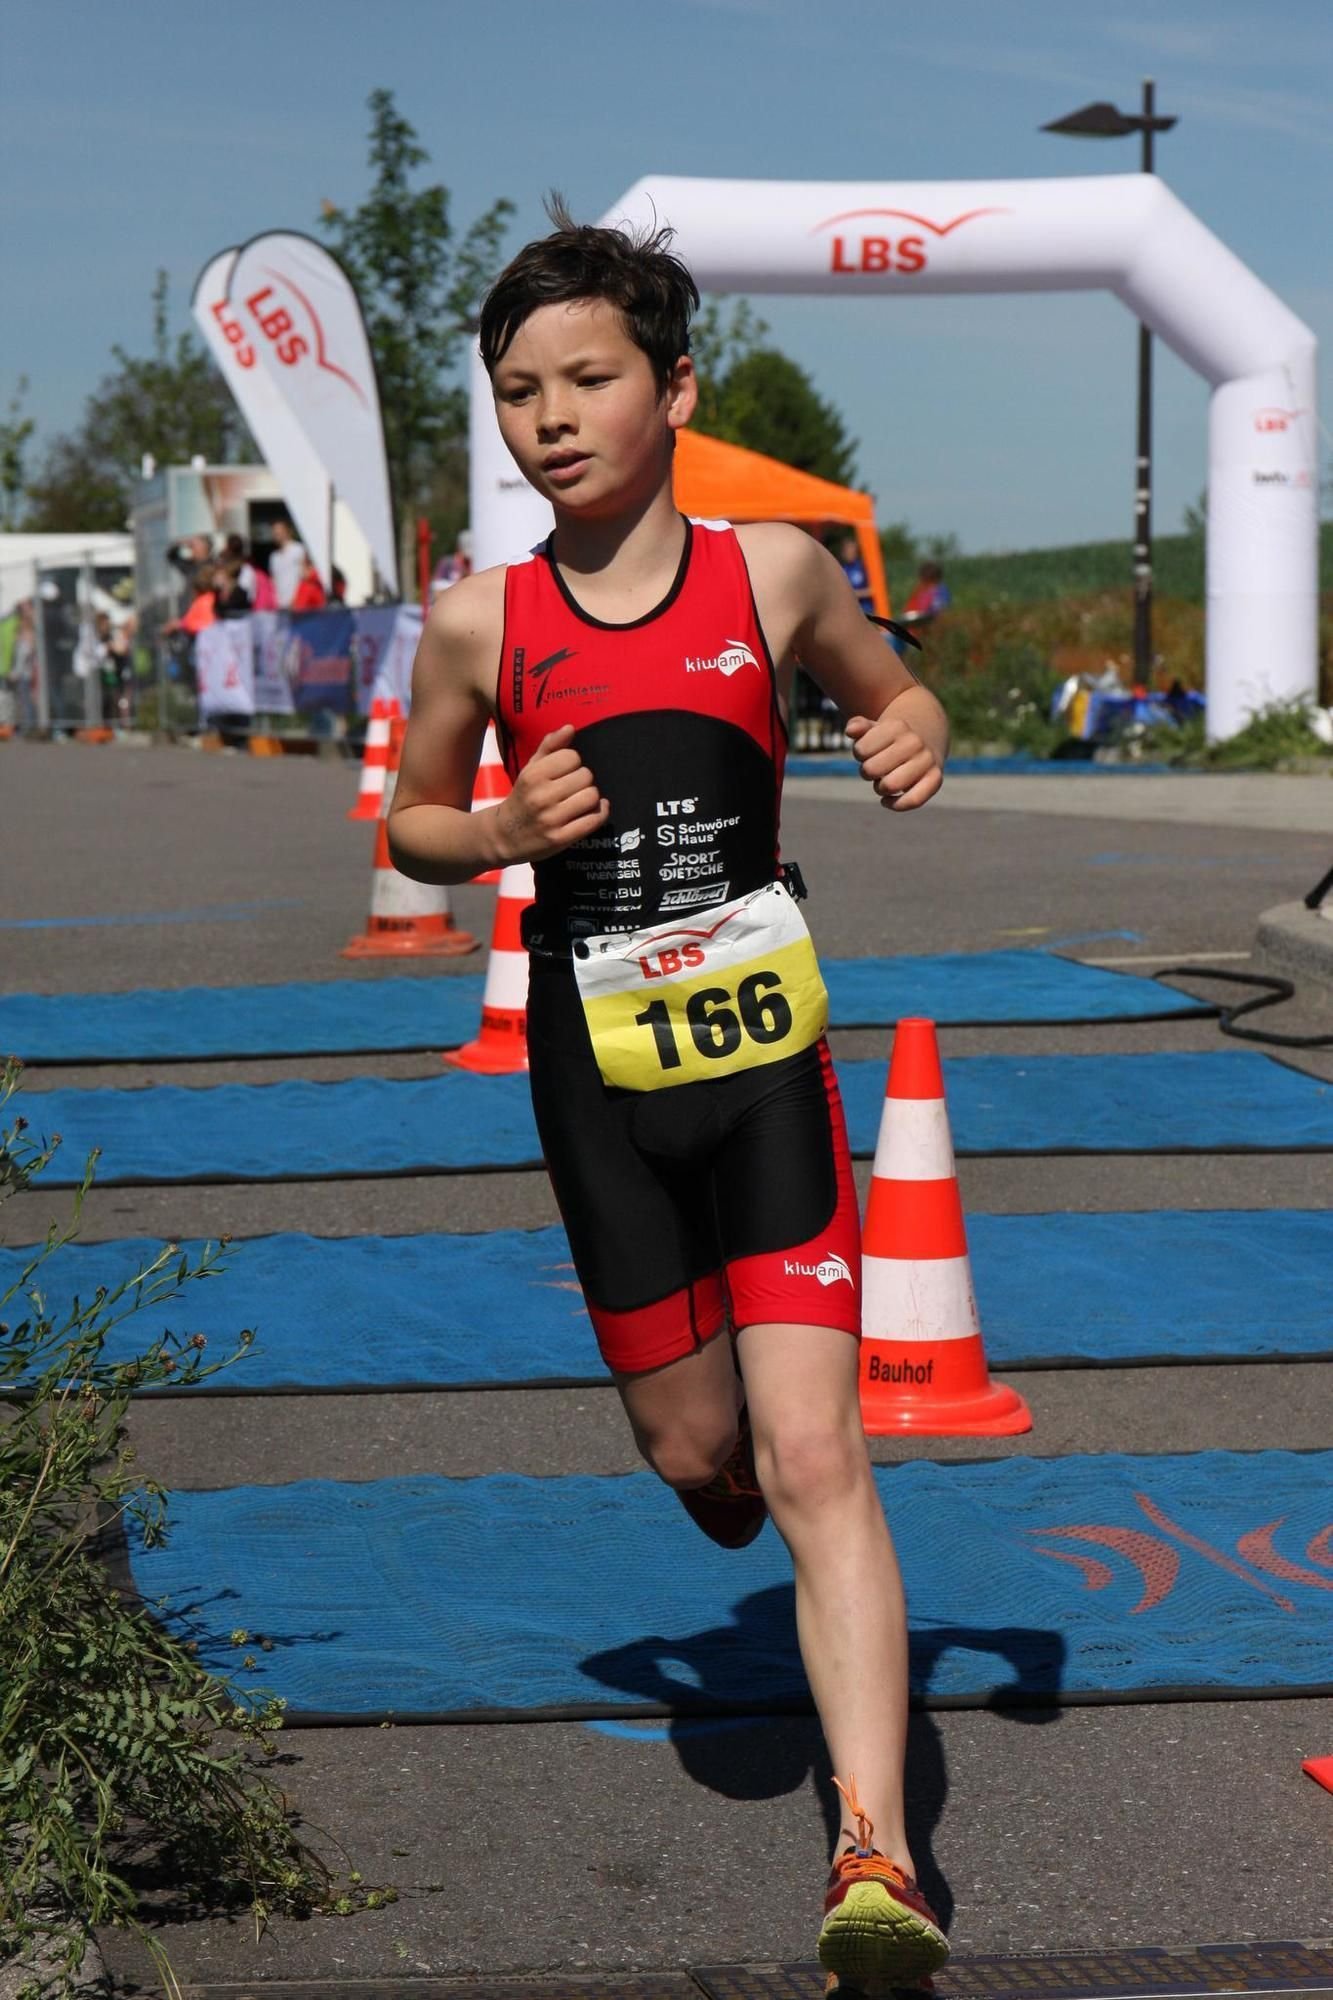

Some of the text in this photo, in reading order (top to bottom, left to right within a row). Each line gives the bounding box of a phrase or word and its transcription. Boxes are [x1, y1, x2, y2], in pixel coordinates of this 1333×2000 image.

[830, 236, 927, 274] LBS
[246, 286, 309, 366] LBS
[685, 651, 747, 673] kiwami
[656, 798, 697, 816] LTS
[678, 816, 741, 834] Schwörer
[678, 833, 716, 845] Haus
[663, 850, 721, 867] SPORT
[658, 862, 724, 881] DIETSCHE
[598, 886, 642, 899] EnBW
[638, 941, 706, 980] LBS
[634, 970, 793, 1070] 166
[784, 1260, 844, 1278] kiwami
[868, 1355, 934, 1384] Bauhof
